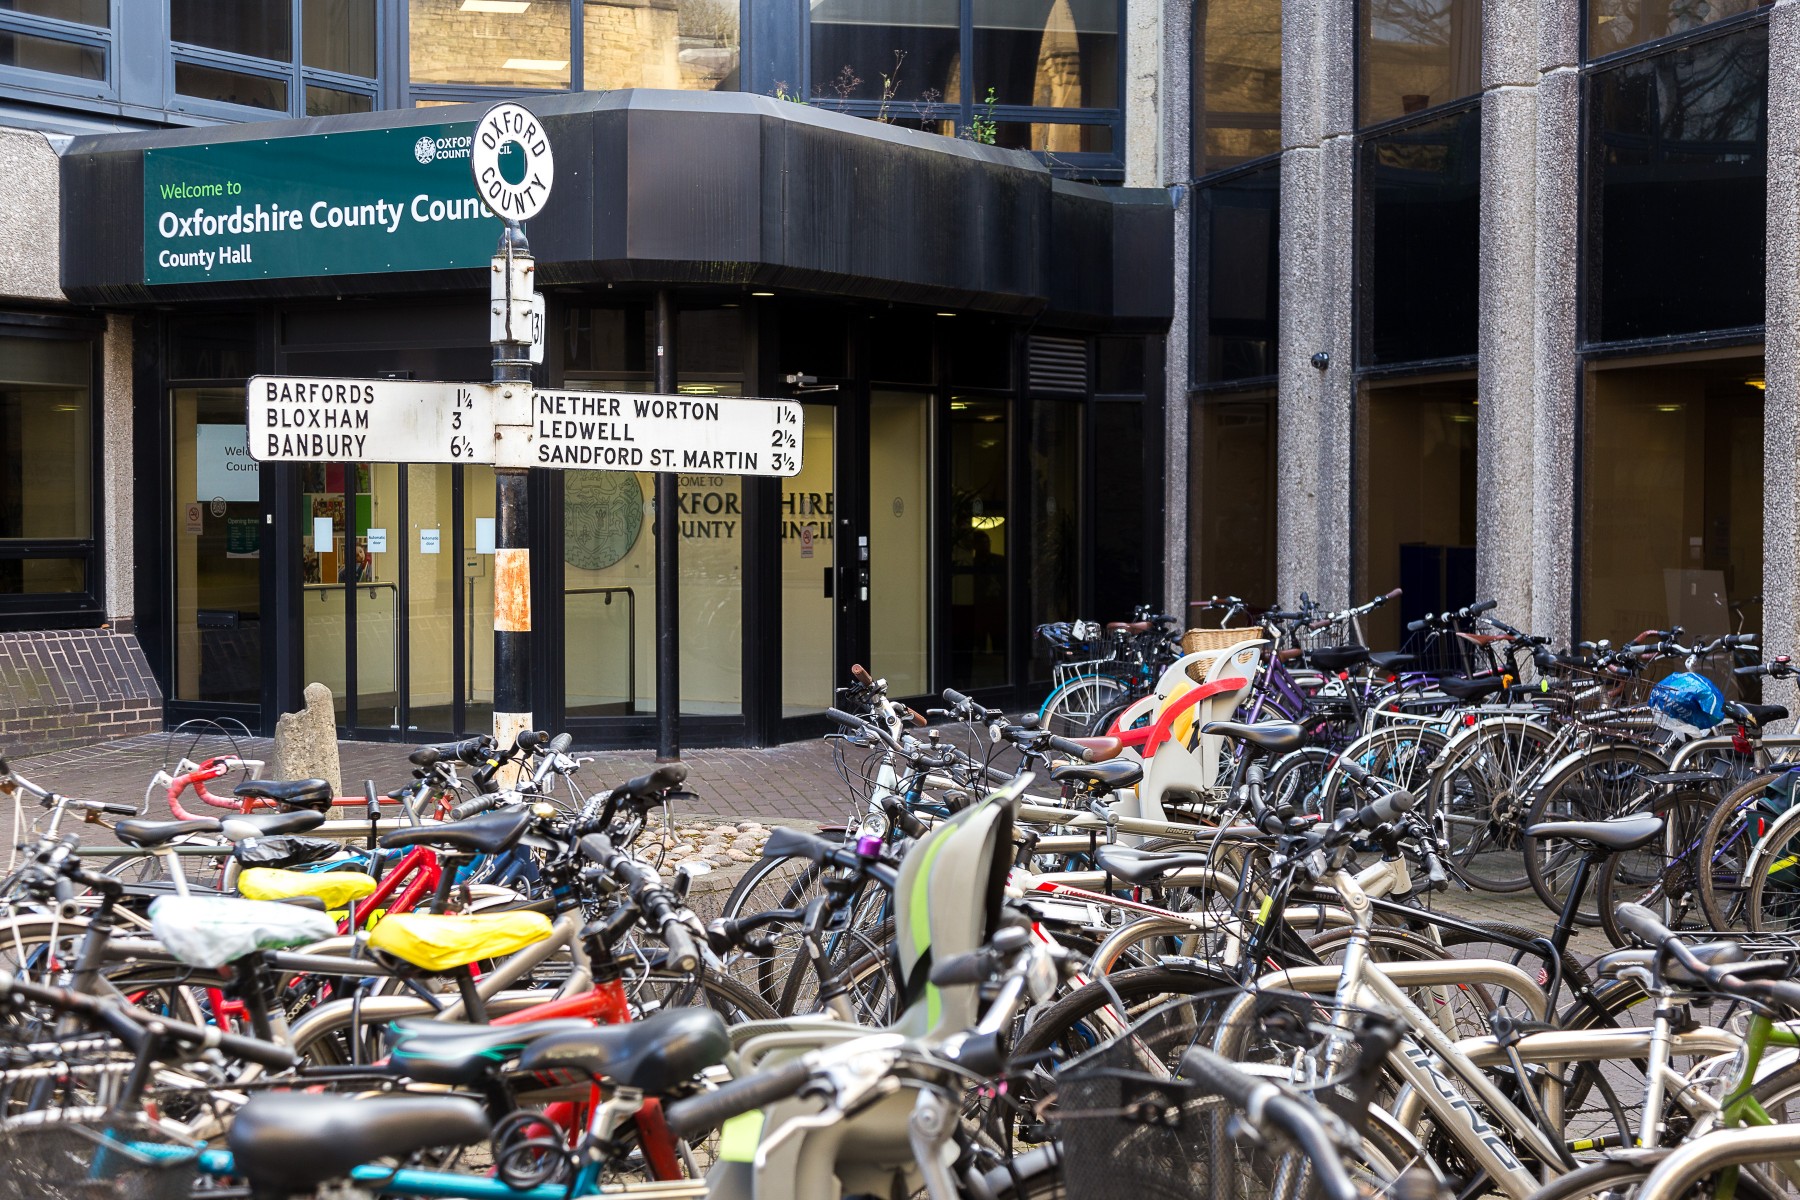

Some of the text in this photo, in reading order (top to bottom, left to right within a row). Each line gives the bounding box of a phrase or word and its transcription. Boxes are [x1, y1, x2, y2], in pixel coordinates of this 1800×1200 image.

[436, 136, 472, 149] OXFOR
[482, 111, 545, 157] OXFORD
[160, 181, 241, 199] Welcome to
[482, 167, 546, 215] COUNTY
[159, 194, 496, 238] Oxfordshire County Counc
[159, 244, 252, 270] County Hall
[267, 383, 374, 404] BARFORDS
[267, 408, 462, 430] BLOXHAM 3
[540, 396, 620, 416] NETHER
[634, 400, 719, 421] WORTON
[540, 420, 635, 441] LEDWELL
[267, 434, 367, 457] BANBURY
[226, 462, 258, 471] Count
[538, 444, 643, 466] SANDFORD
[650, 449, 677, 467] ST.
[684, 451, 758, 470] MARTIN
[709, 476, 723, 487] TO
